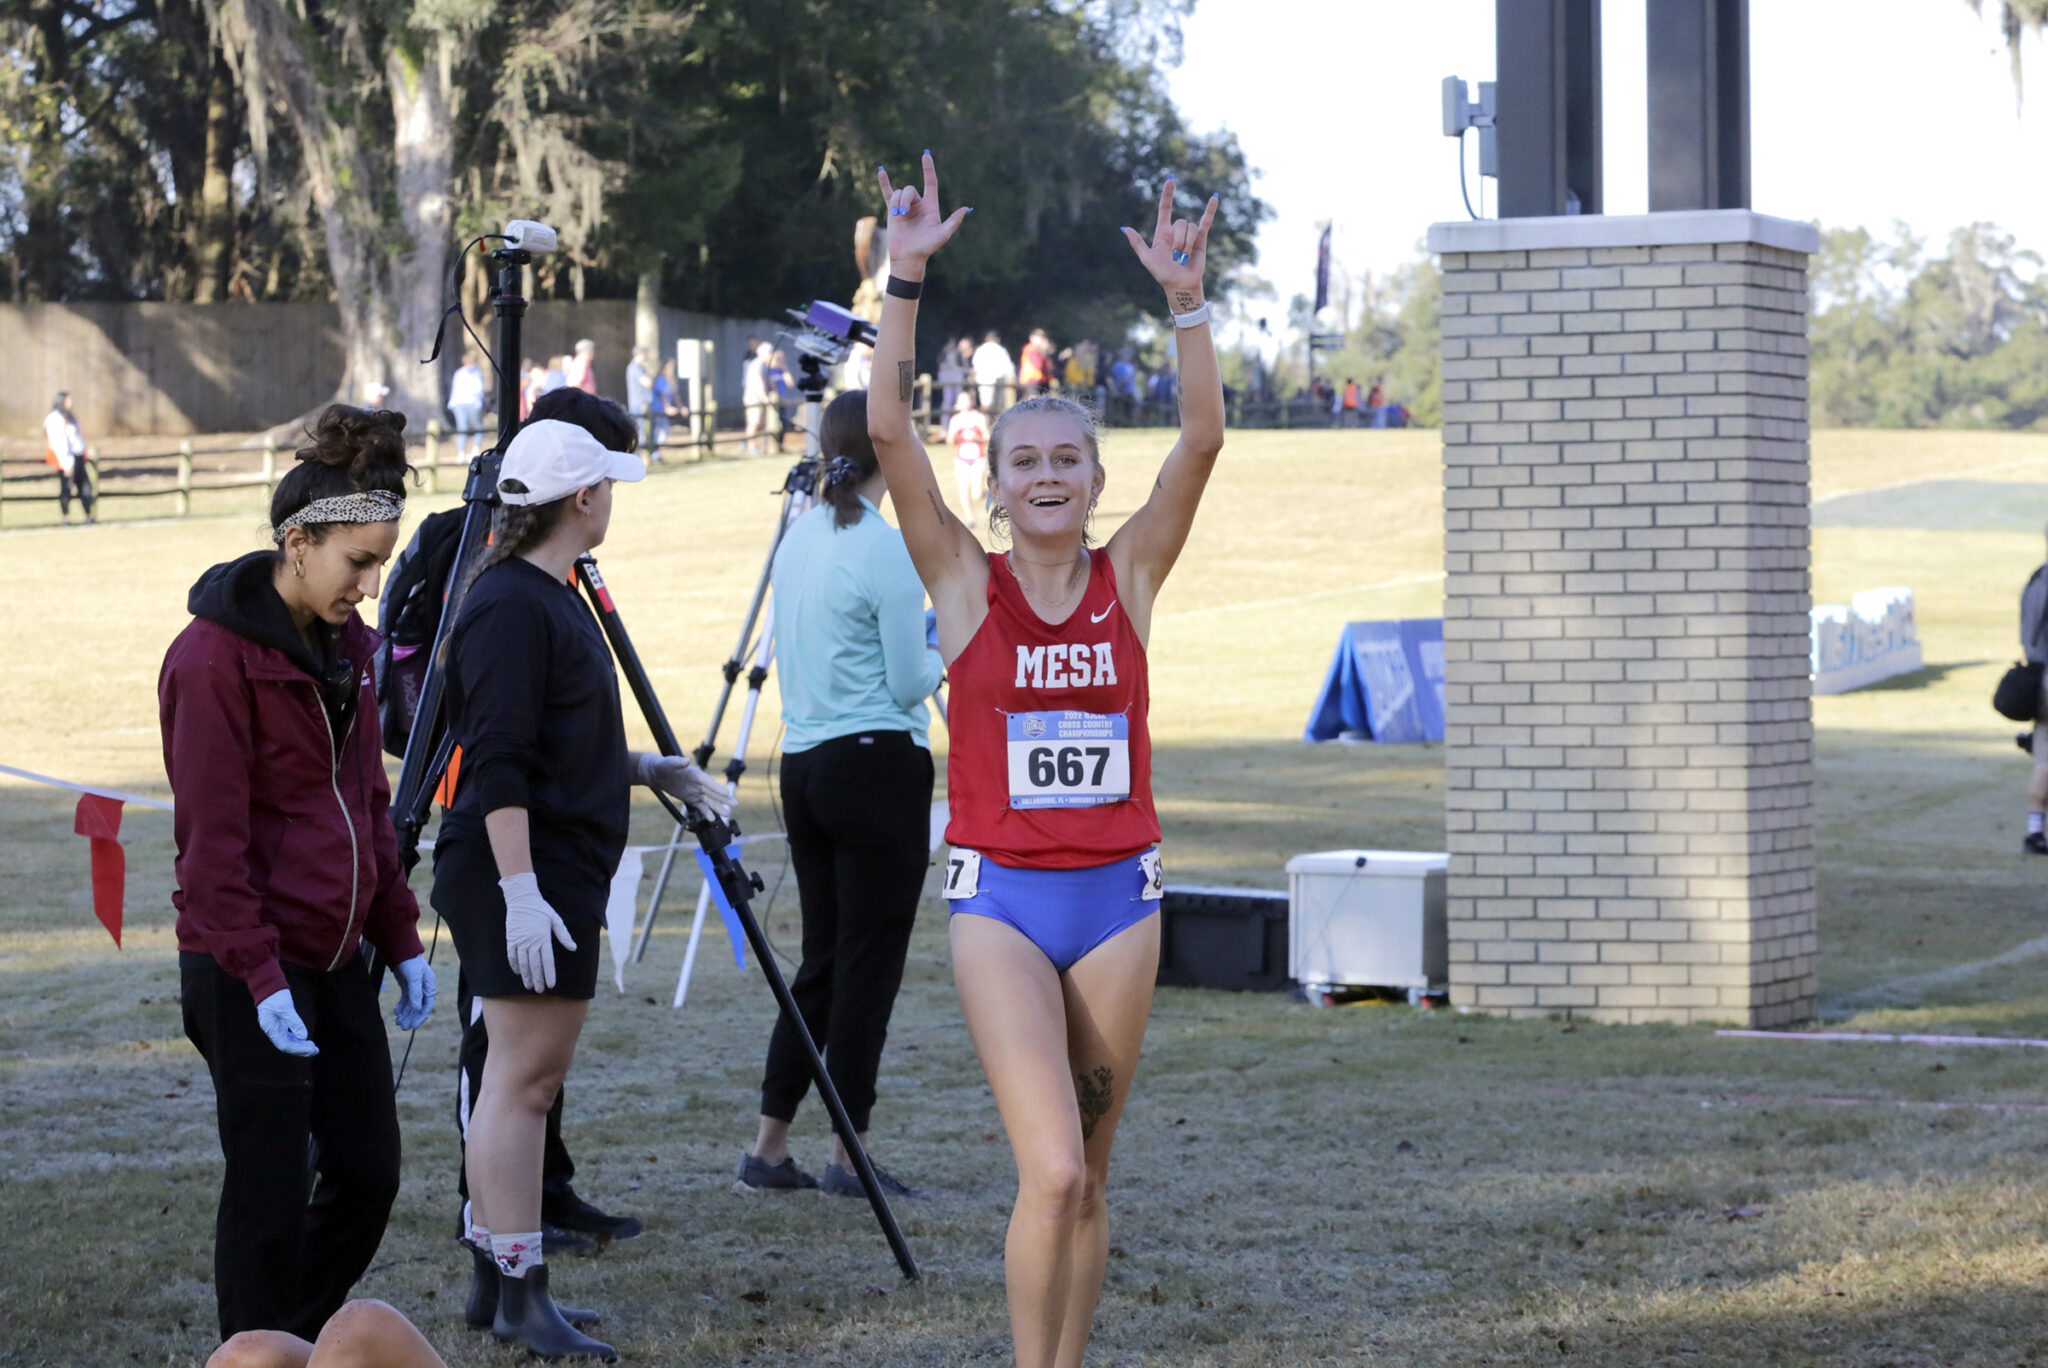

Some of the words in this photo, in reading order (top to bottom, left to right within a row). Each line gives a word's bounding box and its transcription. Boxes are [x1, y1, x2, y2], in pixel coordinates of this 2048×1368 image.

[1015, 642, 1117, 689] MESA
[1058, 720, 1081, 729] CROSS
[1083, 720, 1113, 729] COUNTRY
[1058, 729, 1114, 738] CHAMPIONSHIPS
[1028, 746, 1110, 788] 667
